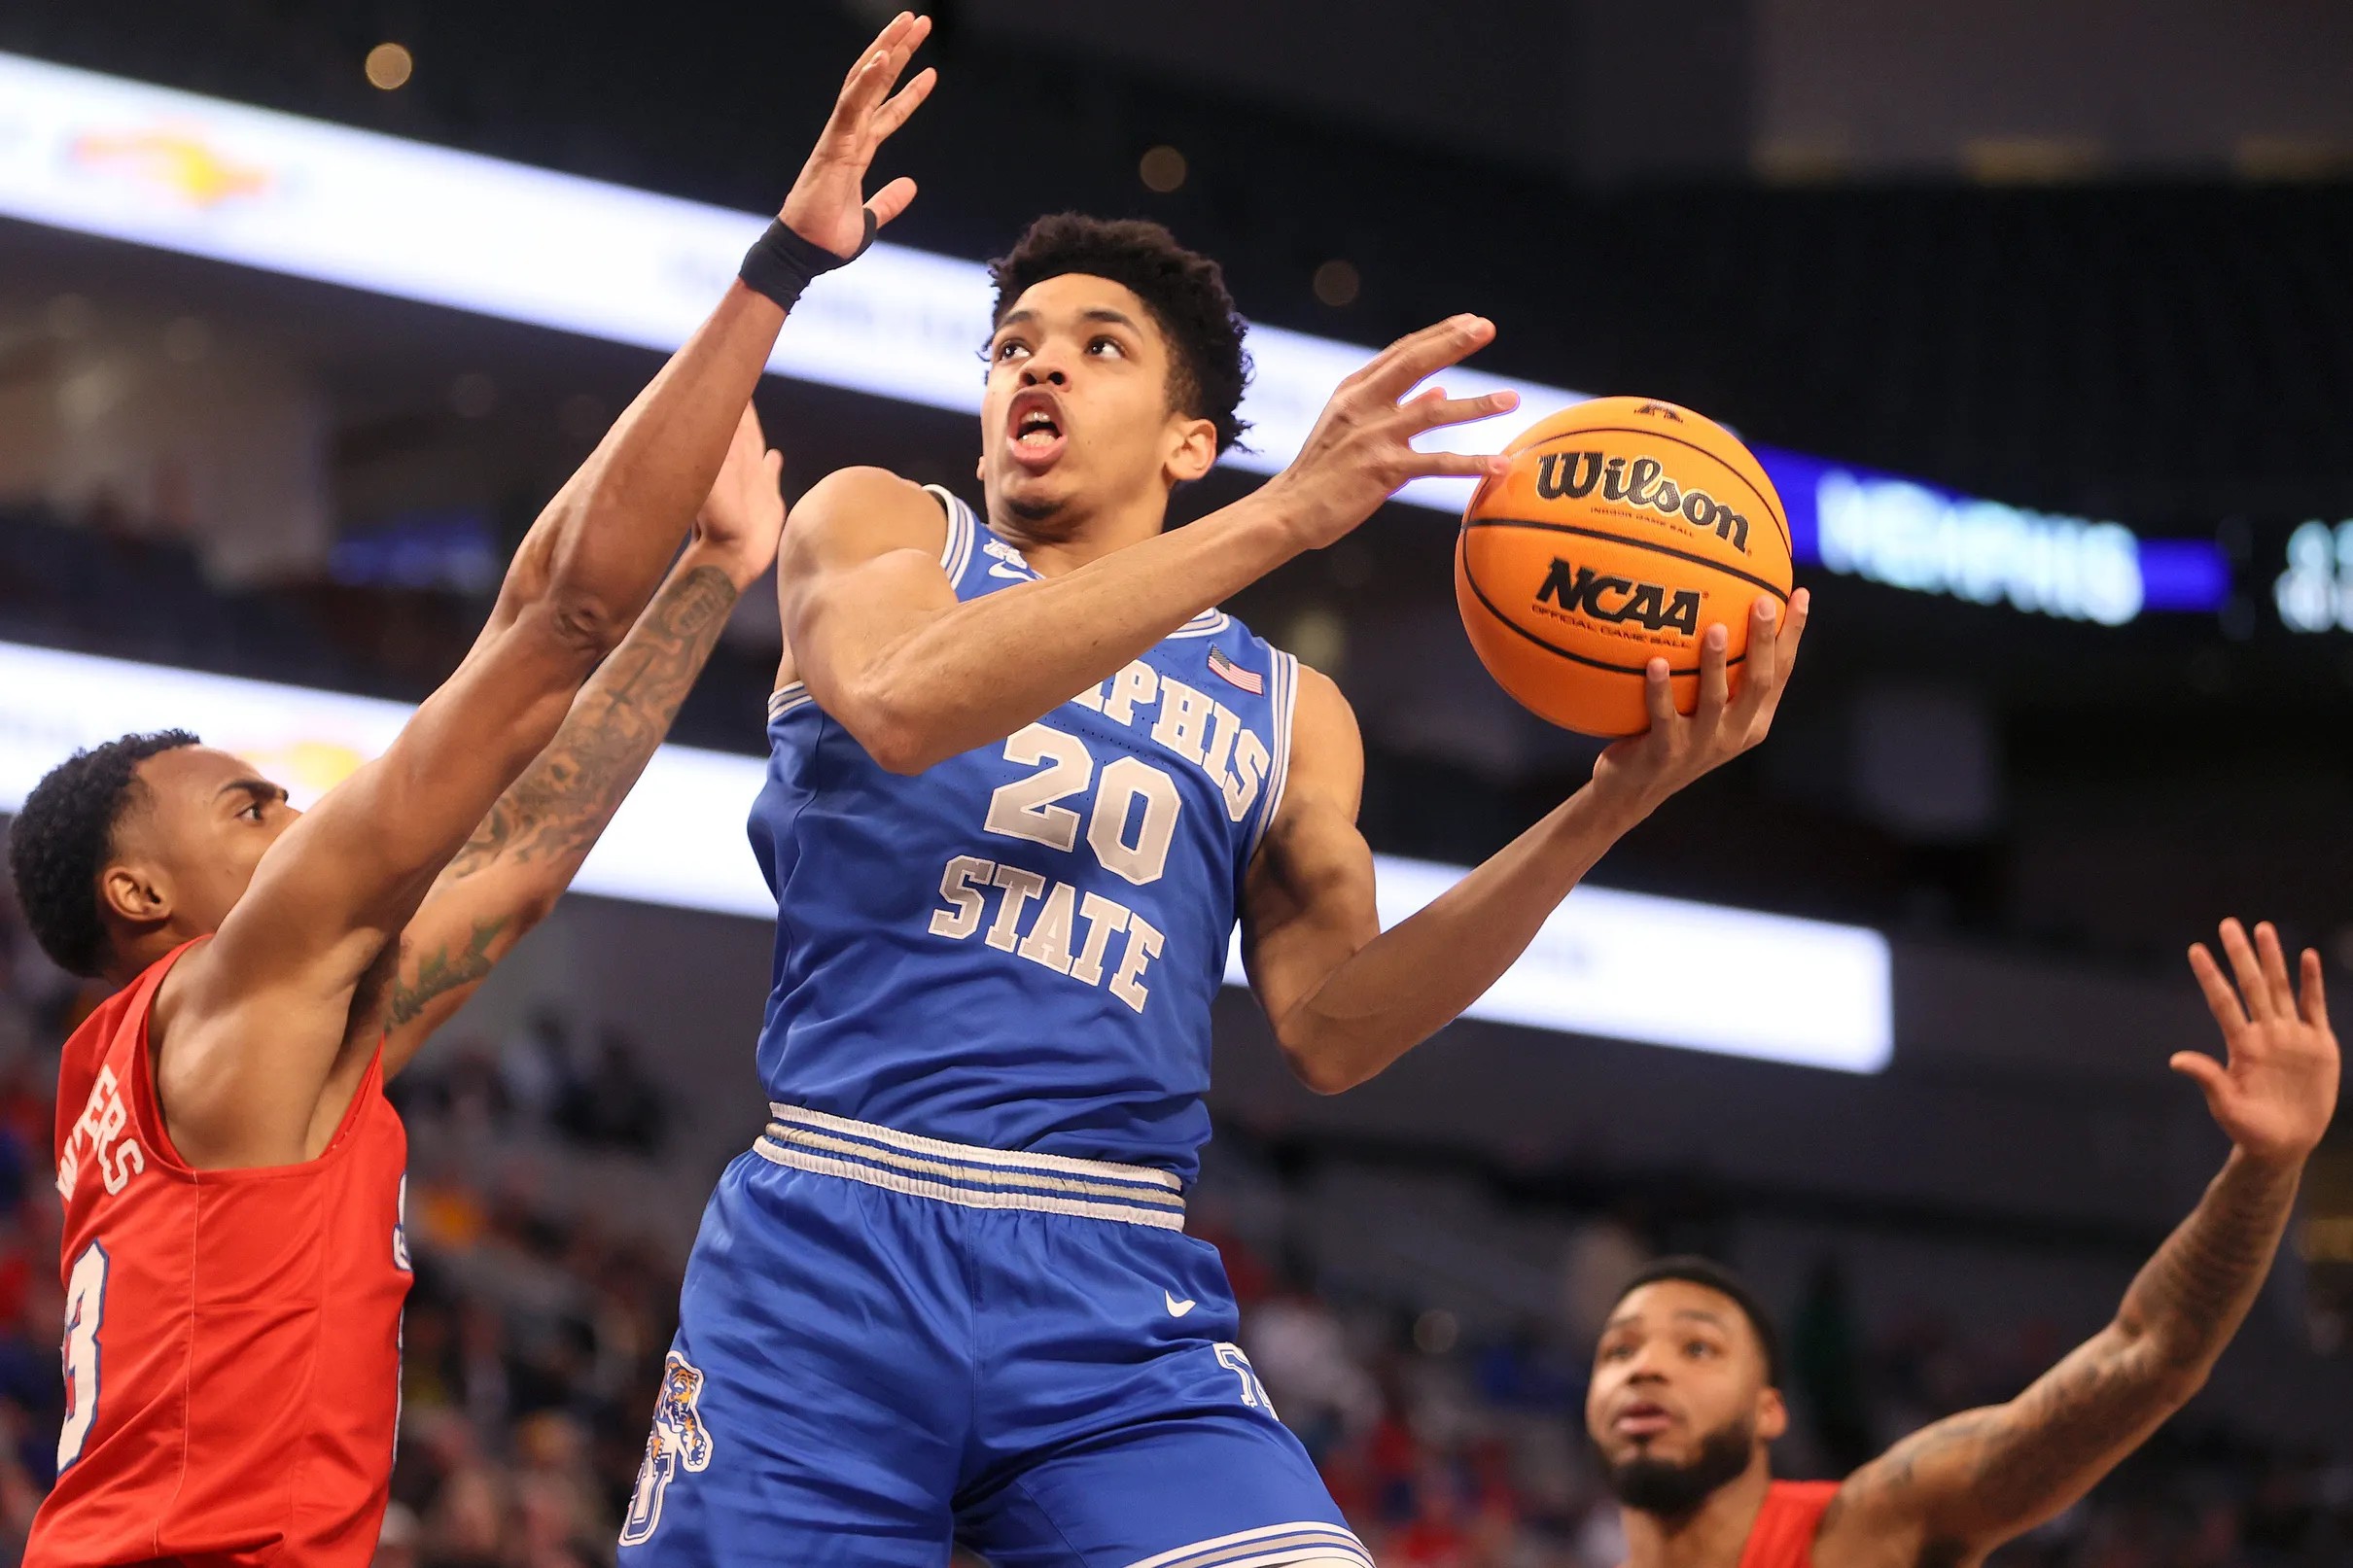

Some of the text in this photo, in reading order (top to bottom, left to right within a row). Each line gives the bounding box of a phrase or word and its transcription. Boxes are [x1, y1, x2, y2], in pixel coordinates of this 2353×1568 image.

[1536, 452, 1750, 555] Wilson
[1669, 524, 1695, 538] BALL
[1531, 604, 1692, 649] OFFICIAL GAME BALL
[1535, 556, 1702, 637] NCAA
[1070, 659, 1271, 822] PHIS
[983, 722, 1182, 886] 20
[928, 854, 1166, 1015] STATE
